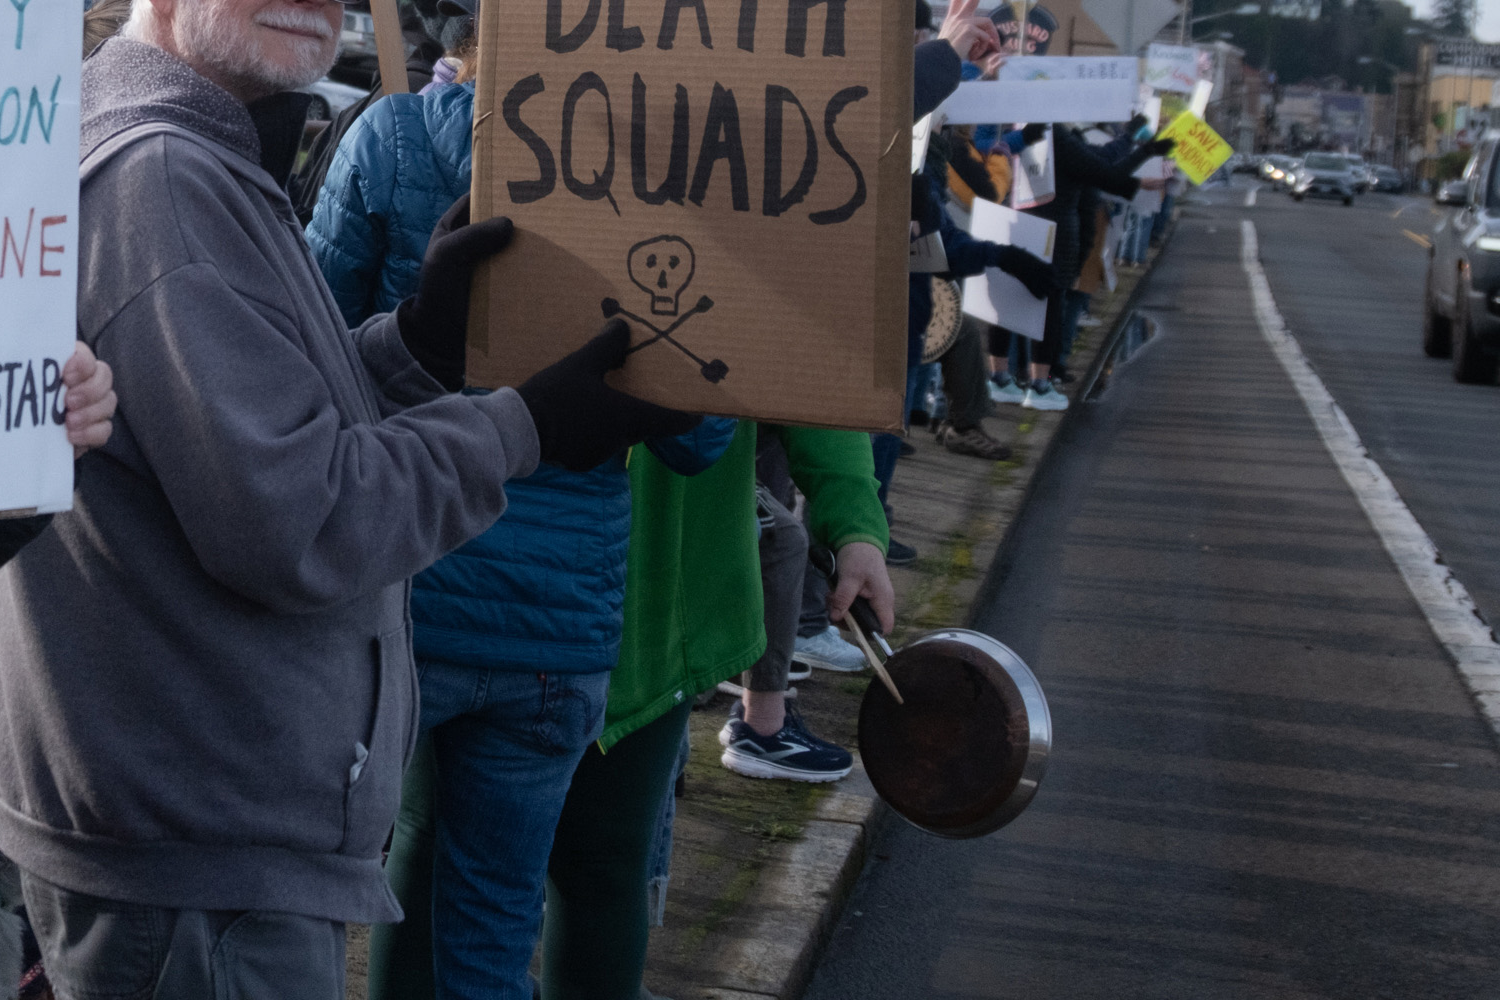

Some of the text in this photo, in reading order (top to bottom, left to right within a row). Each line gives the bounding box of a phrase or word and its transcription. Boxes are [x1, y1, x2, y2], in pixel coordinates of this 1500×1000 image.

[996, 20, 1049, 43] USARD
[503, 71, 869, 225] SQUADS
[1188, 121, 1220, 153] SAVE
